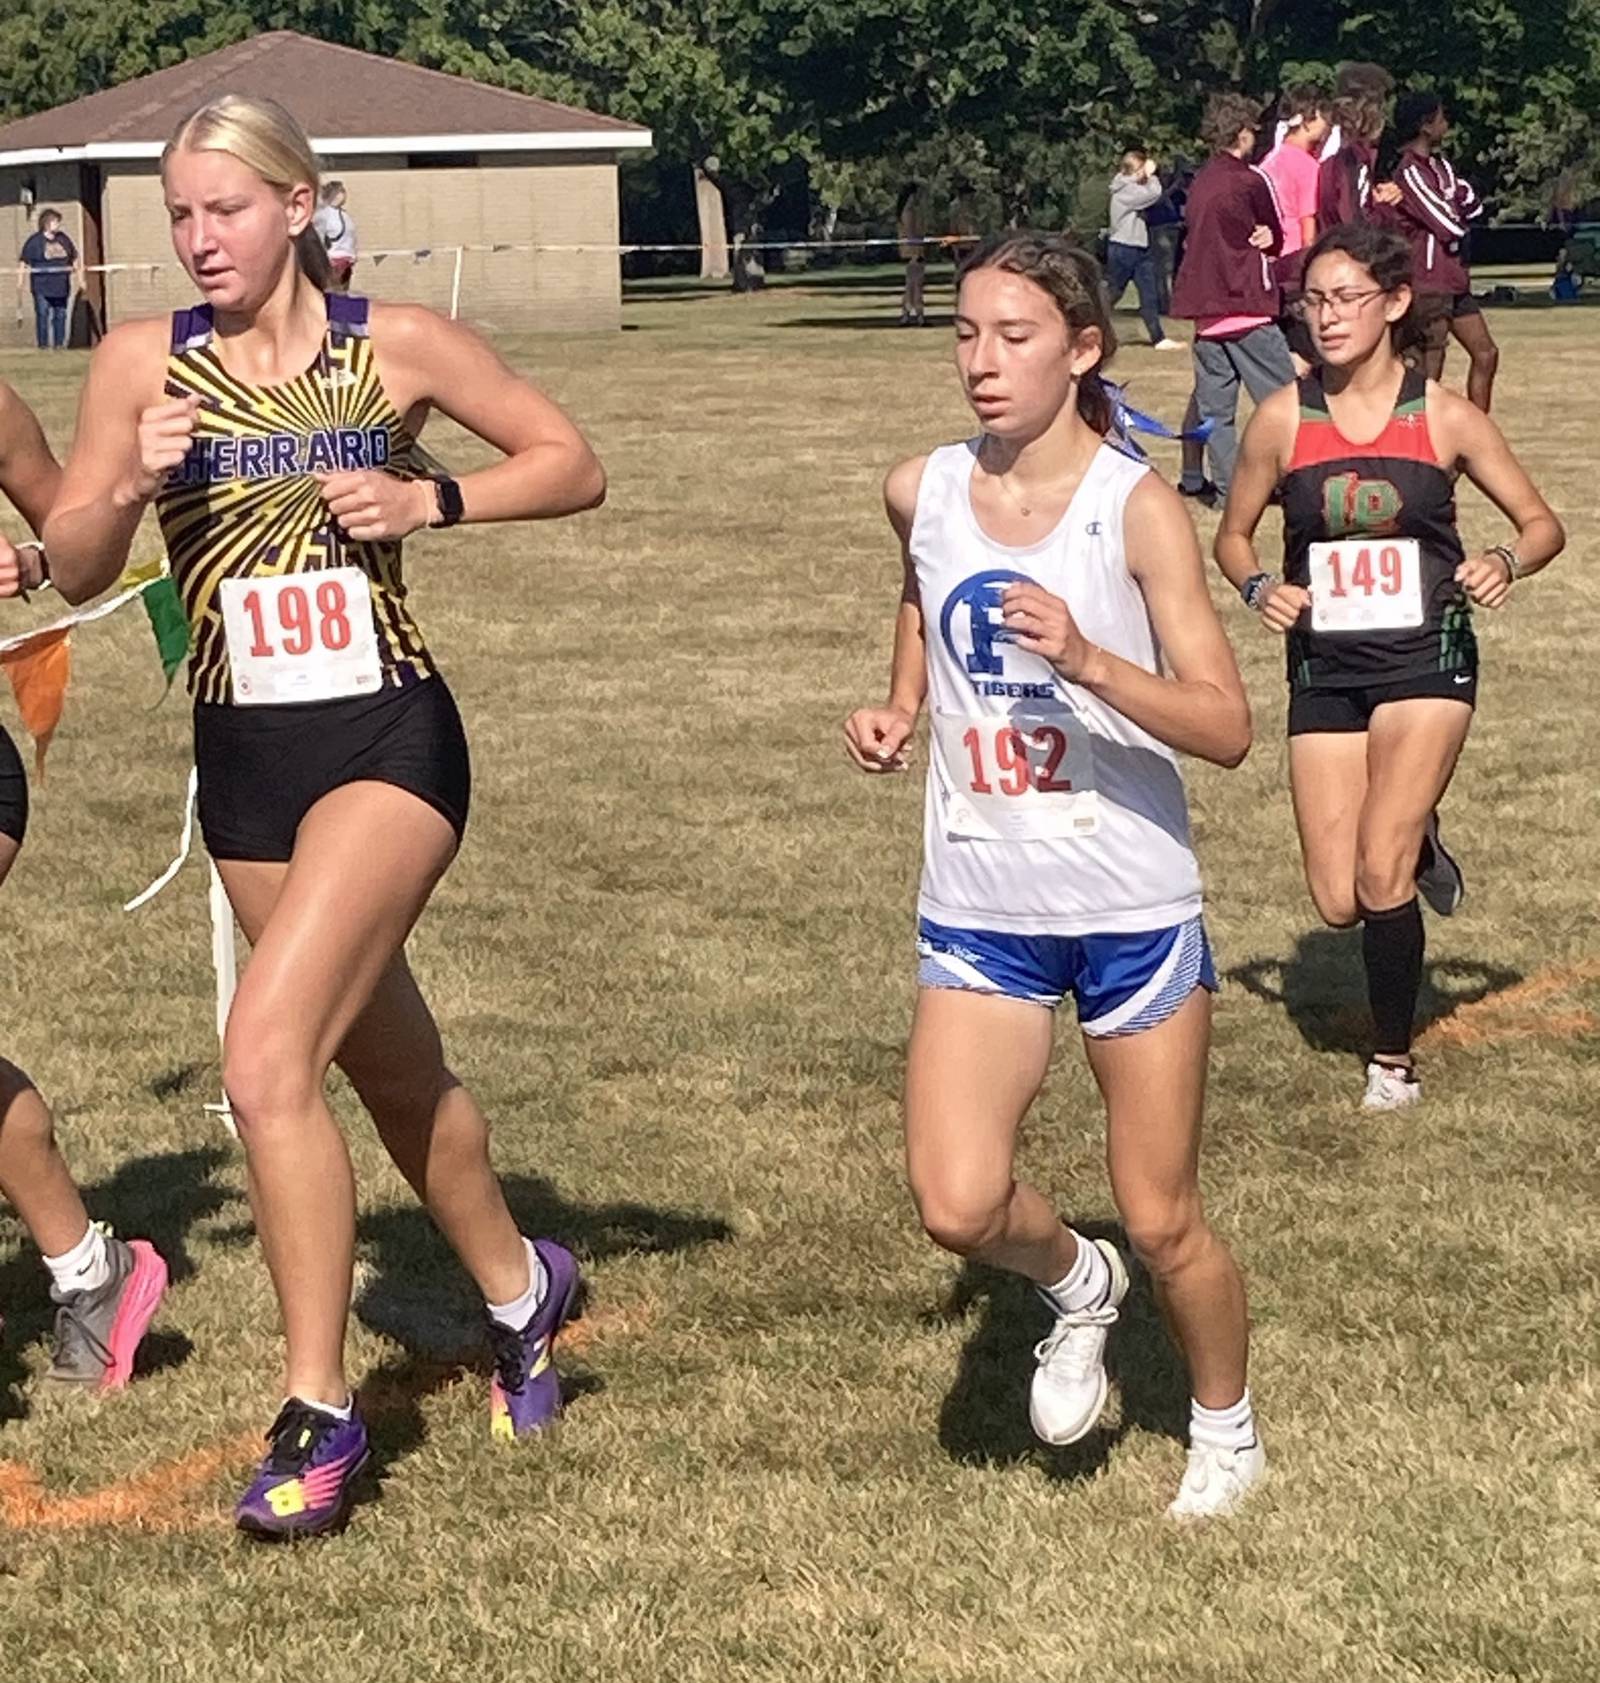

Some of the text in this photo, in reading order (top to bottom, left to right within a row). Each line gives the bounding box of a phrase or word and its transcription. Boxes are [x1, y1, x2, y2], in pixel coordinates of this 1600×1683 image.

[167, 426, 389, 487] HERRARD
[1328, 546, 1403, 598] 149
[243, 580, 352, 658] 198
[971, 680, 1055, 698] TIGERS
[963, 725, 1072, 796] 192
